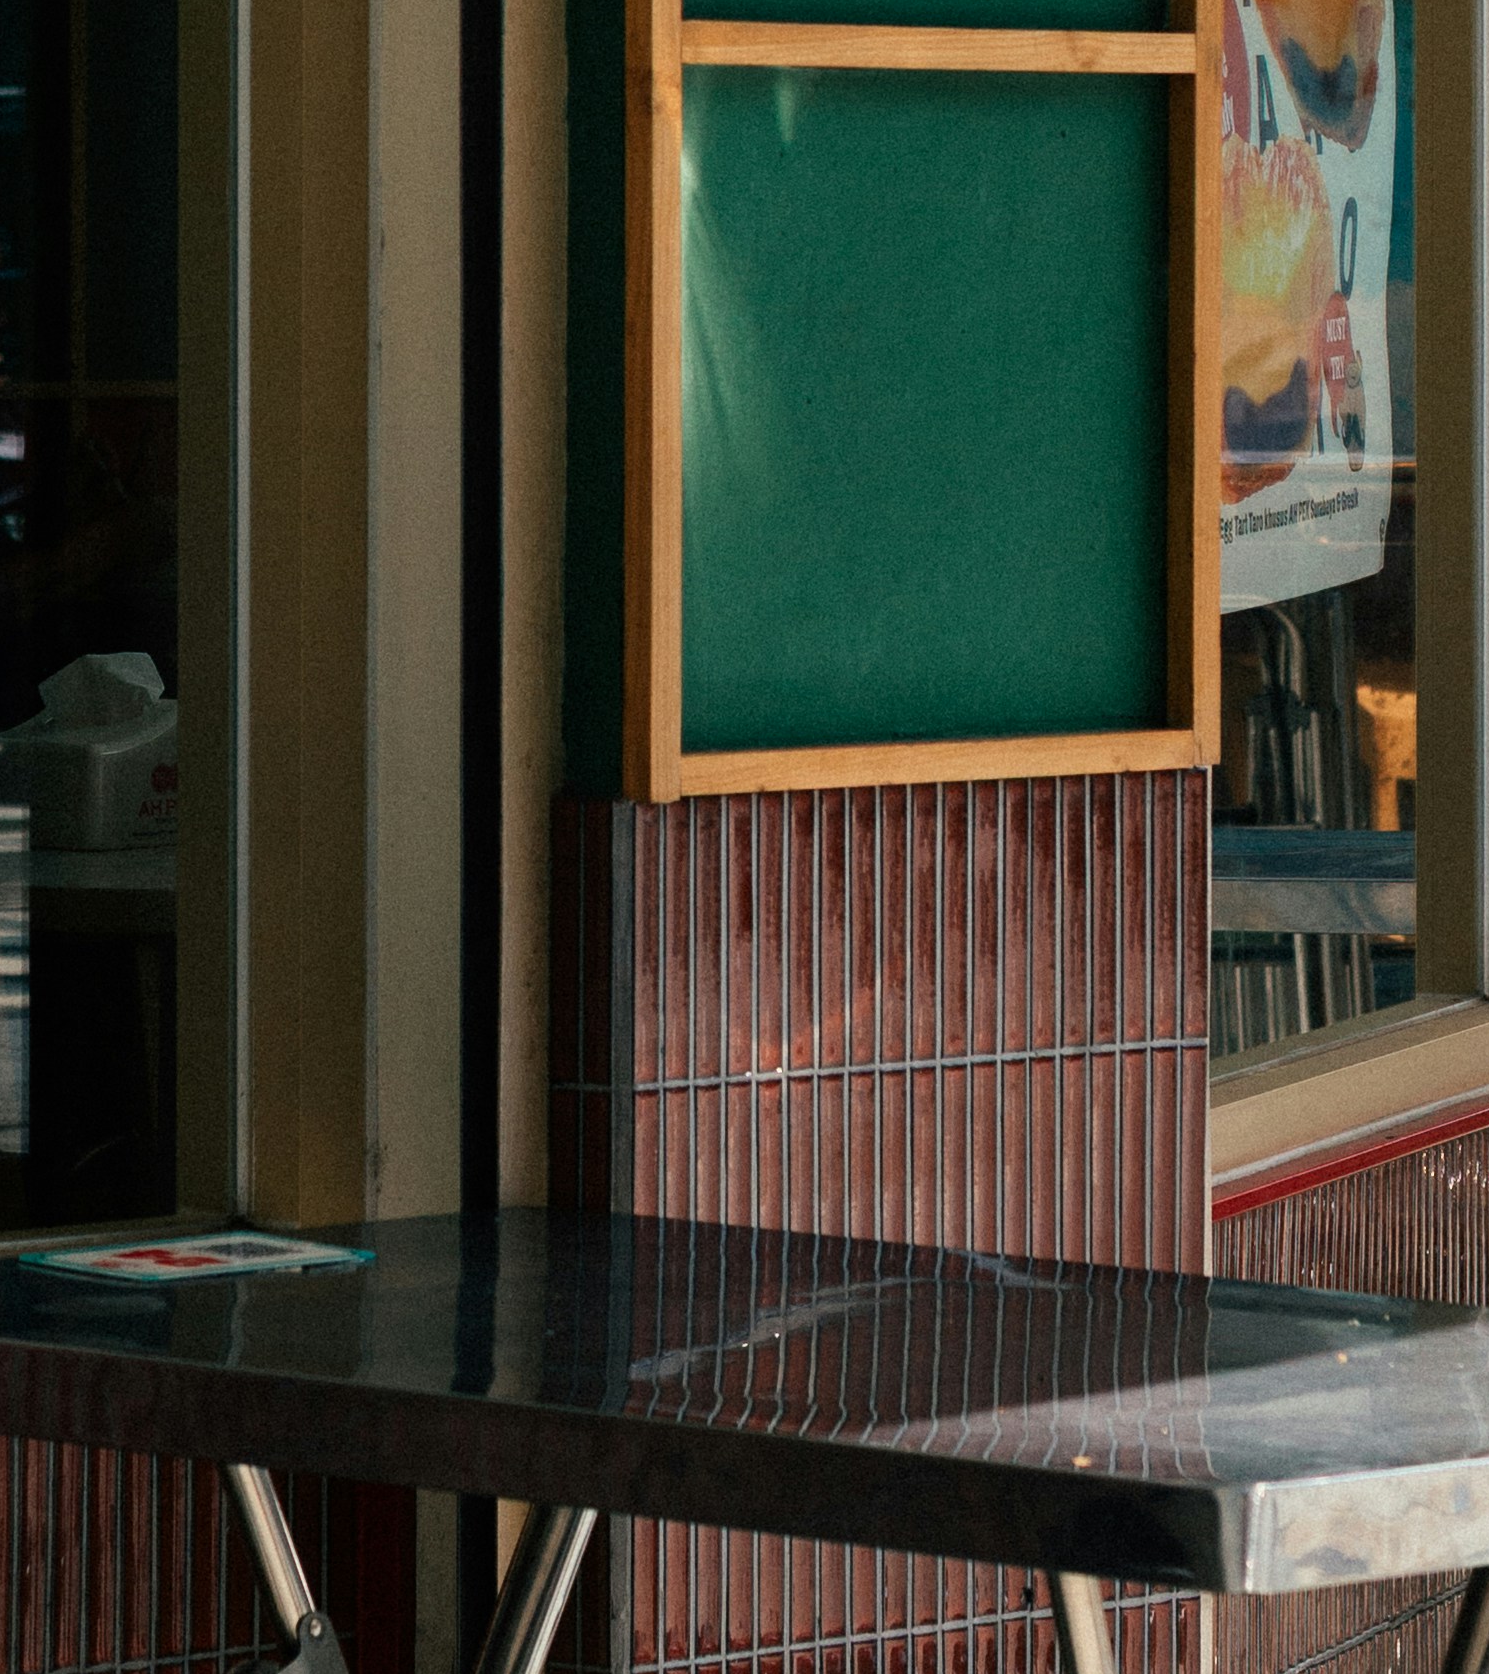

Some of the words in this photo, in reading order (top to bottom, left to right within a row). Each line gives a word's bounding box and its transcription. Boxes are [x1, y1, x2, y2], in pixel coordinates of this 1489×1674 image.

[1326, 317, 1346, 343] MUST
[1234, 513, 1249, 537] Tart
[1249, 511, 1264, 534] Taro
[1264, 507, 1289, 530] khusus
[1289, 502, 1298, 525] AH
[1298, 500, 1310, 523] PEK
